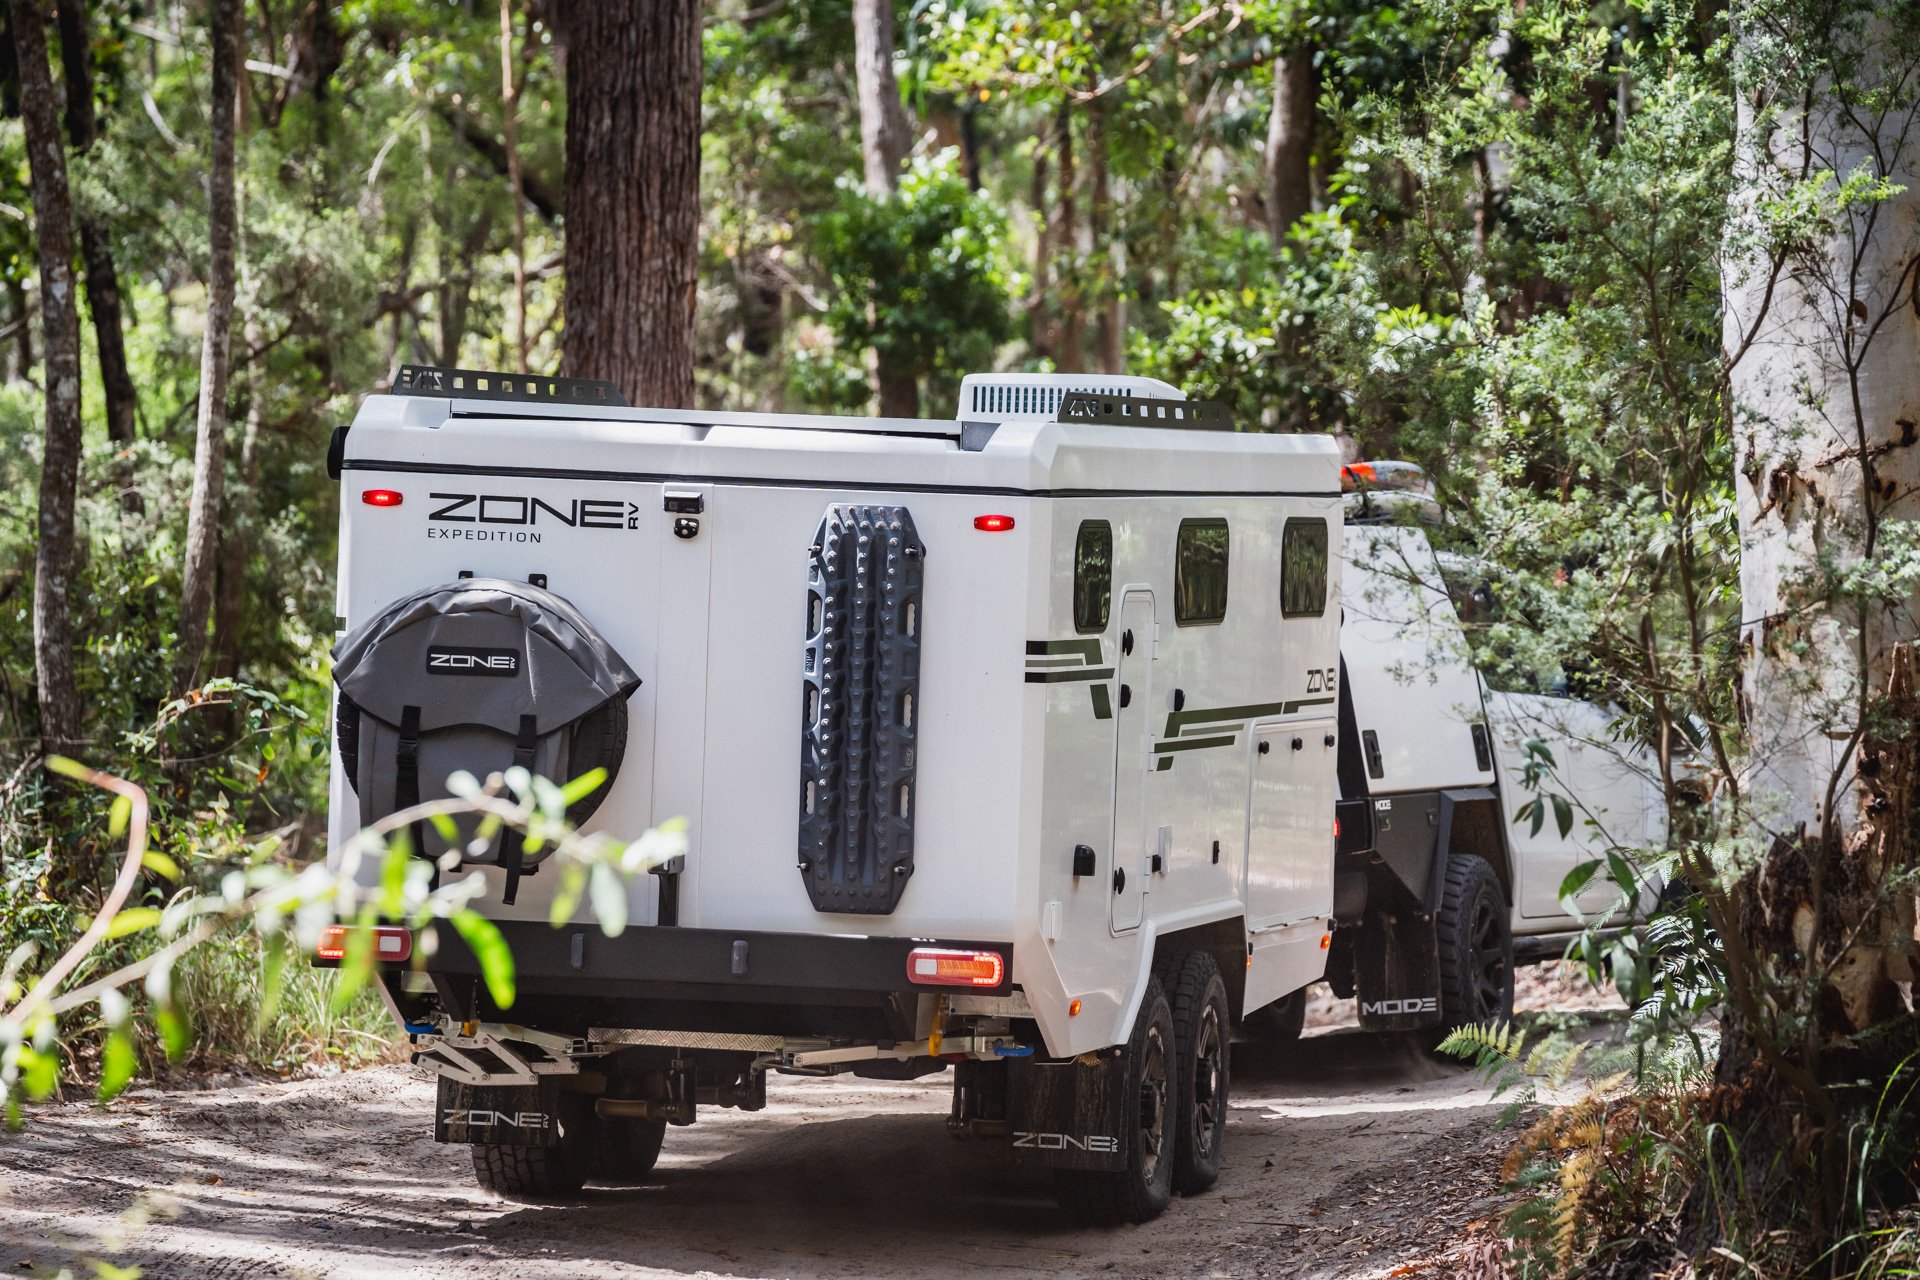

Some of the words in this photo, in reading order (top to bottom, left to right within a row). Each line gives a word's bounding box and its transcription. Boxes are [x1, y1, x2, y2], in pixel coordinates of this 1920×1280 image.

[428, 492, 625, 530] ZONE
[627, 501, 640, 530] RV
[427, 527, 542, 544] EXPEDITION
[430, 653, 510, 669] ZONE
[1306, 667, 1335, 694] ZONE
[1361, 997, 1437, 1016] MODE
[443, 1108, 542, 1128] ZONE
[1012, 1131, 1111, 1152] ZONE
[1111, 1136, 1119, 1153] RV
